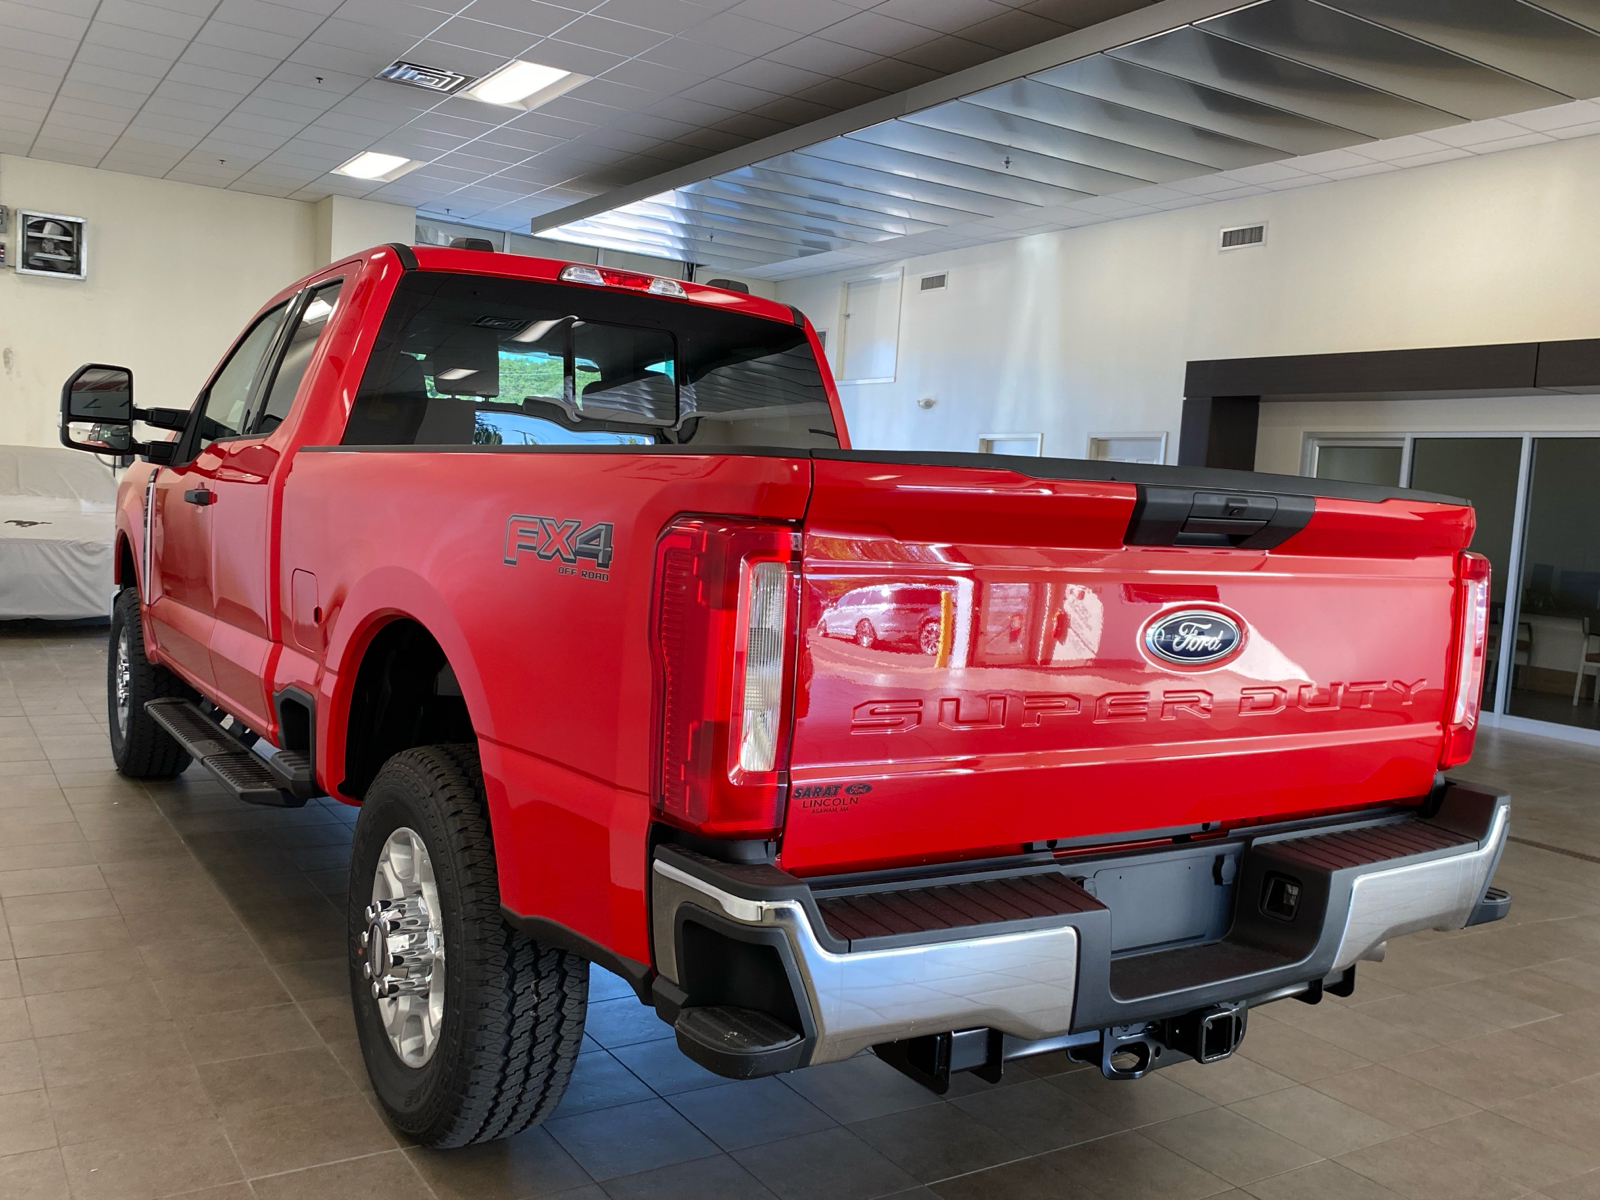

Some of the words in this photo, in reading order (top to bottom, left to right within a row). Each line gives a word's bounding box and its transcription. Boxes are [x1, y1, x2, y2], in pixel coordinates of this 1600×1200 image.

[503, 513, 614, 570] FX4
[558, 566, 577, 576] OFF
[581, 570, 609, 582] ROAD
[1172, 621, 1224, 652] Ford
[851, 689, 1214, 735] SUPER
[1238, 678, 1427, 717] DUTY
[792, 784, 842, 798] SARAT
[802, 797, 859, 808] LINCOLN
